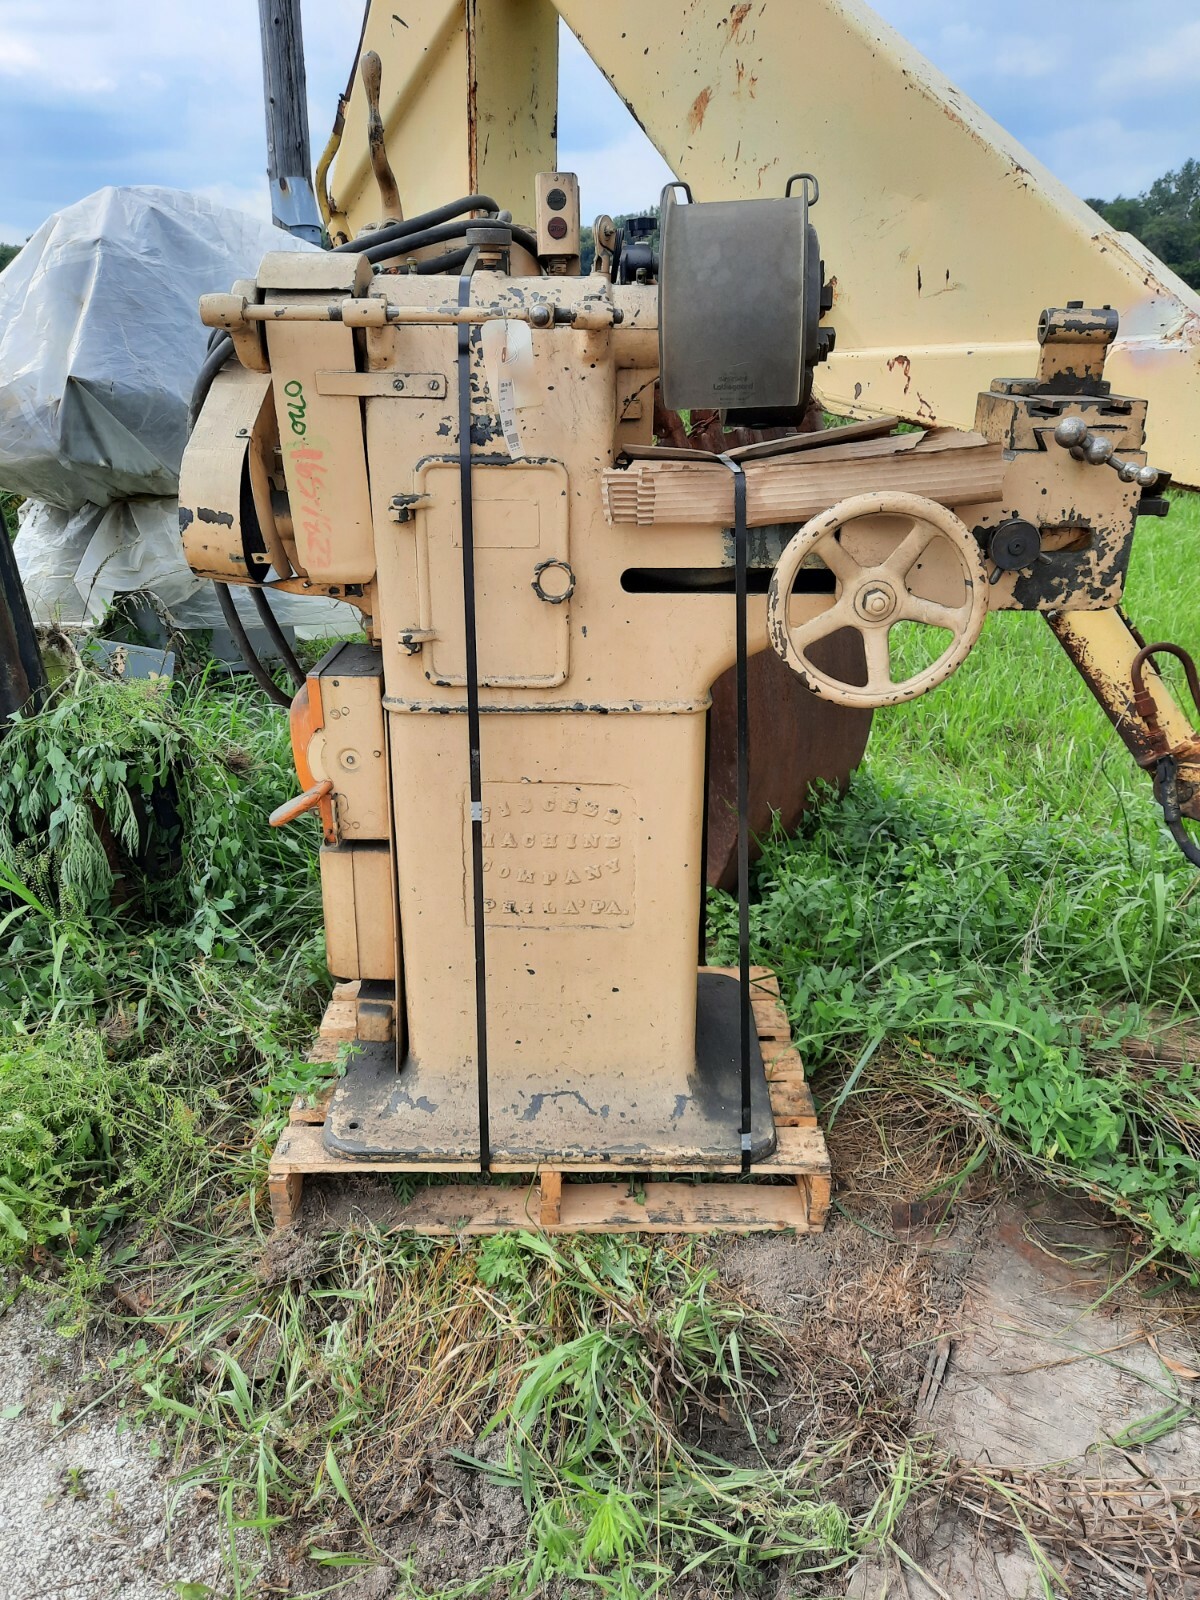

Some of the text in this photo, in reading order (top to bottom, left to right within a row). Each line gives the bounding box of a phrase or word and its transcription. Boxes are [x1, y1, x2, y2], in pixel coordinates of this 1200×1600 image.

[550, 224, 565, 232] STOP
[482, 832, 621, 849] MACHINE
[482, 857, 620, 886] COMPANY
